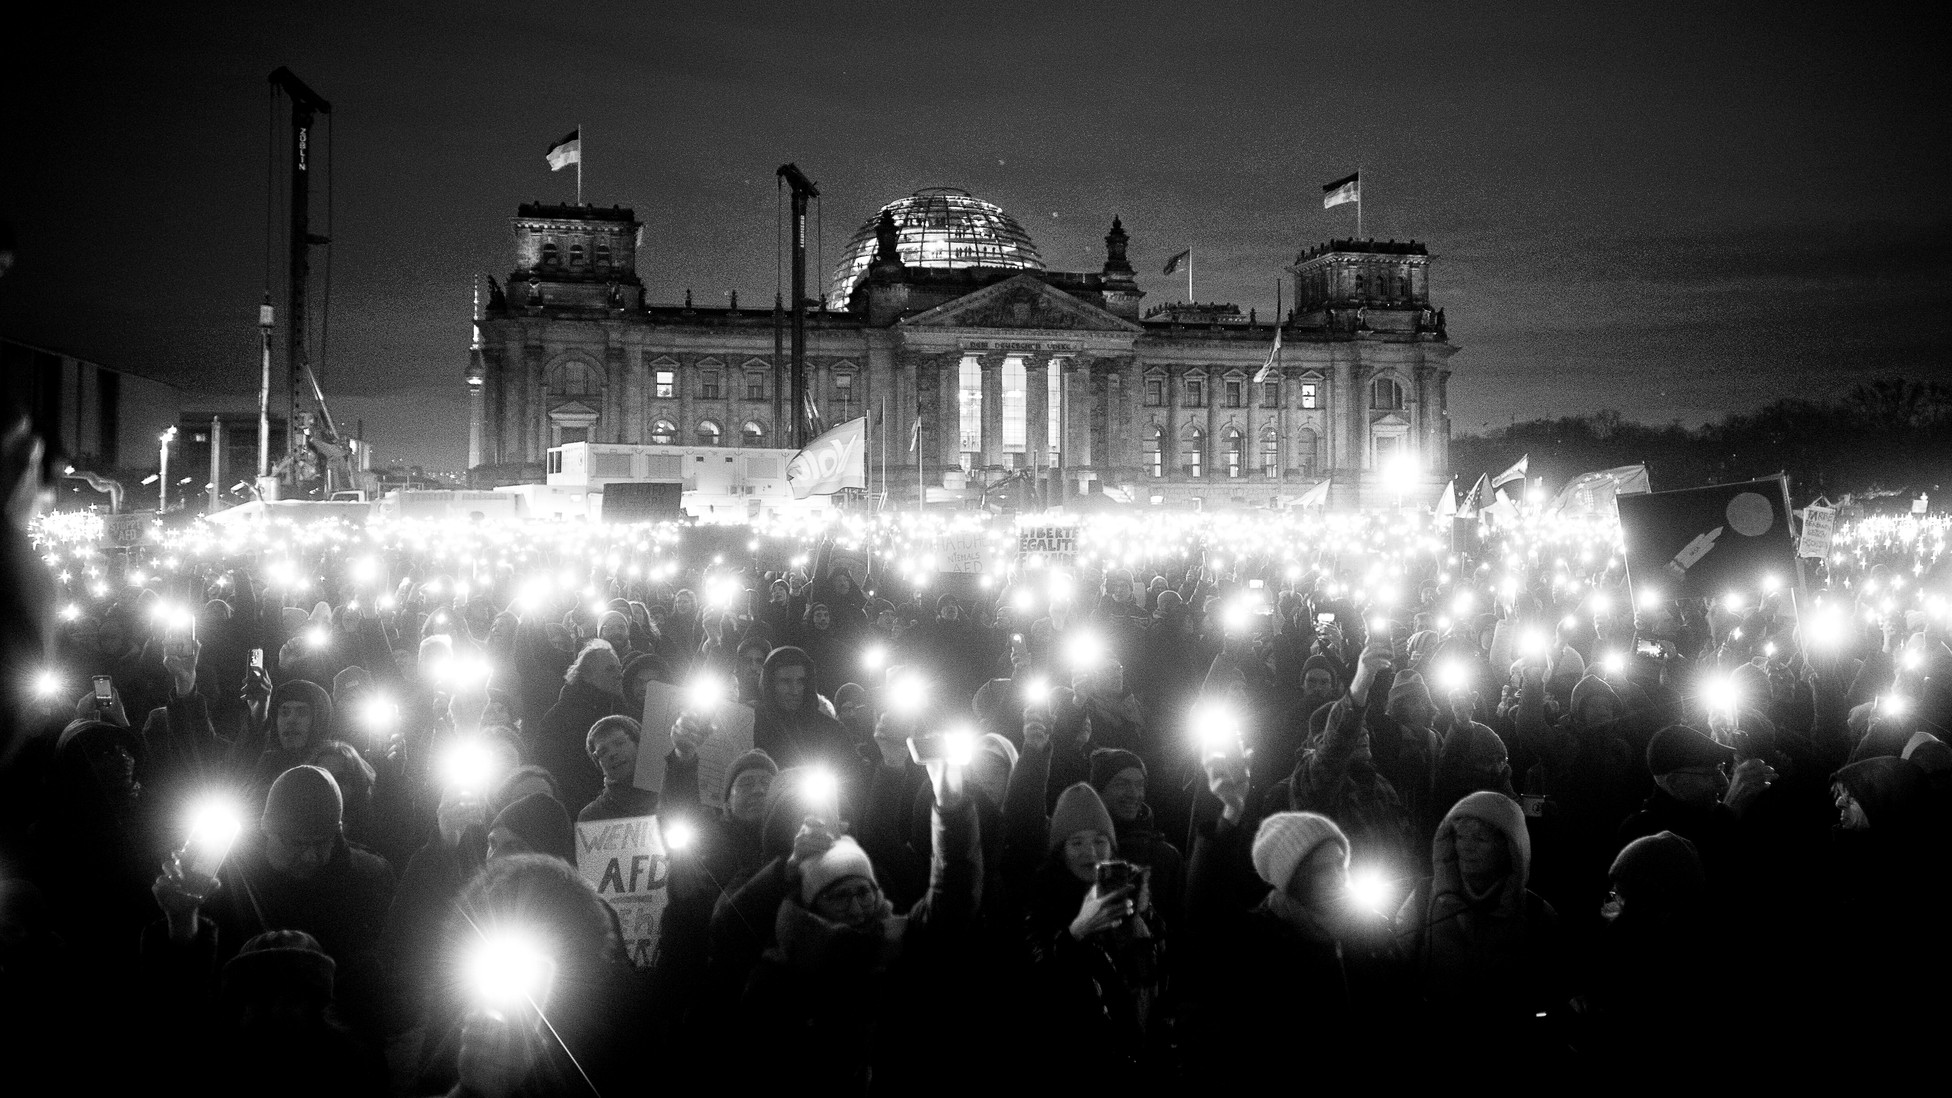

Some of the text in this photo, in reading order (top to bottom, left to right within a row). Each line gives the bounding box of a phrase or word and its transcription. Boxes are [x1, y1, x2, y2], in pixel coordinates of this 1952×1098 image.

[947, 551, 980, 564] NIEMALS
[953, 560, 983, 573] AFD
[597, 854, 668, 894] AFD
